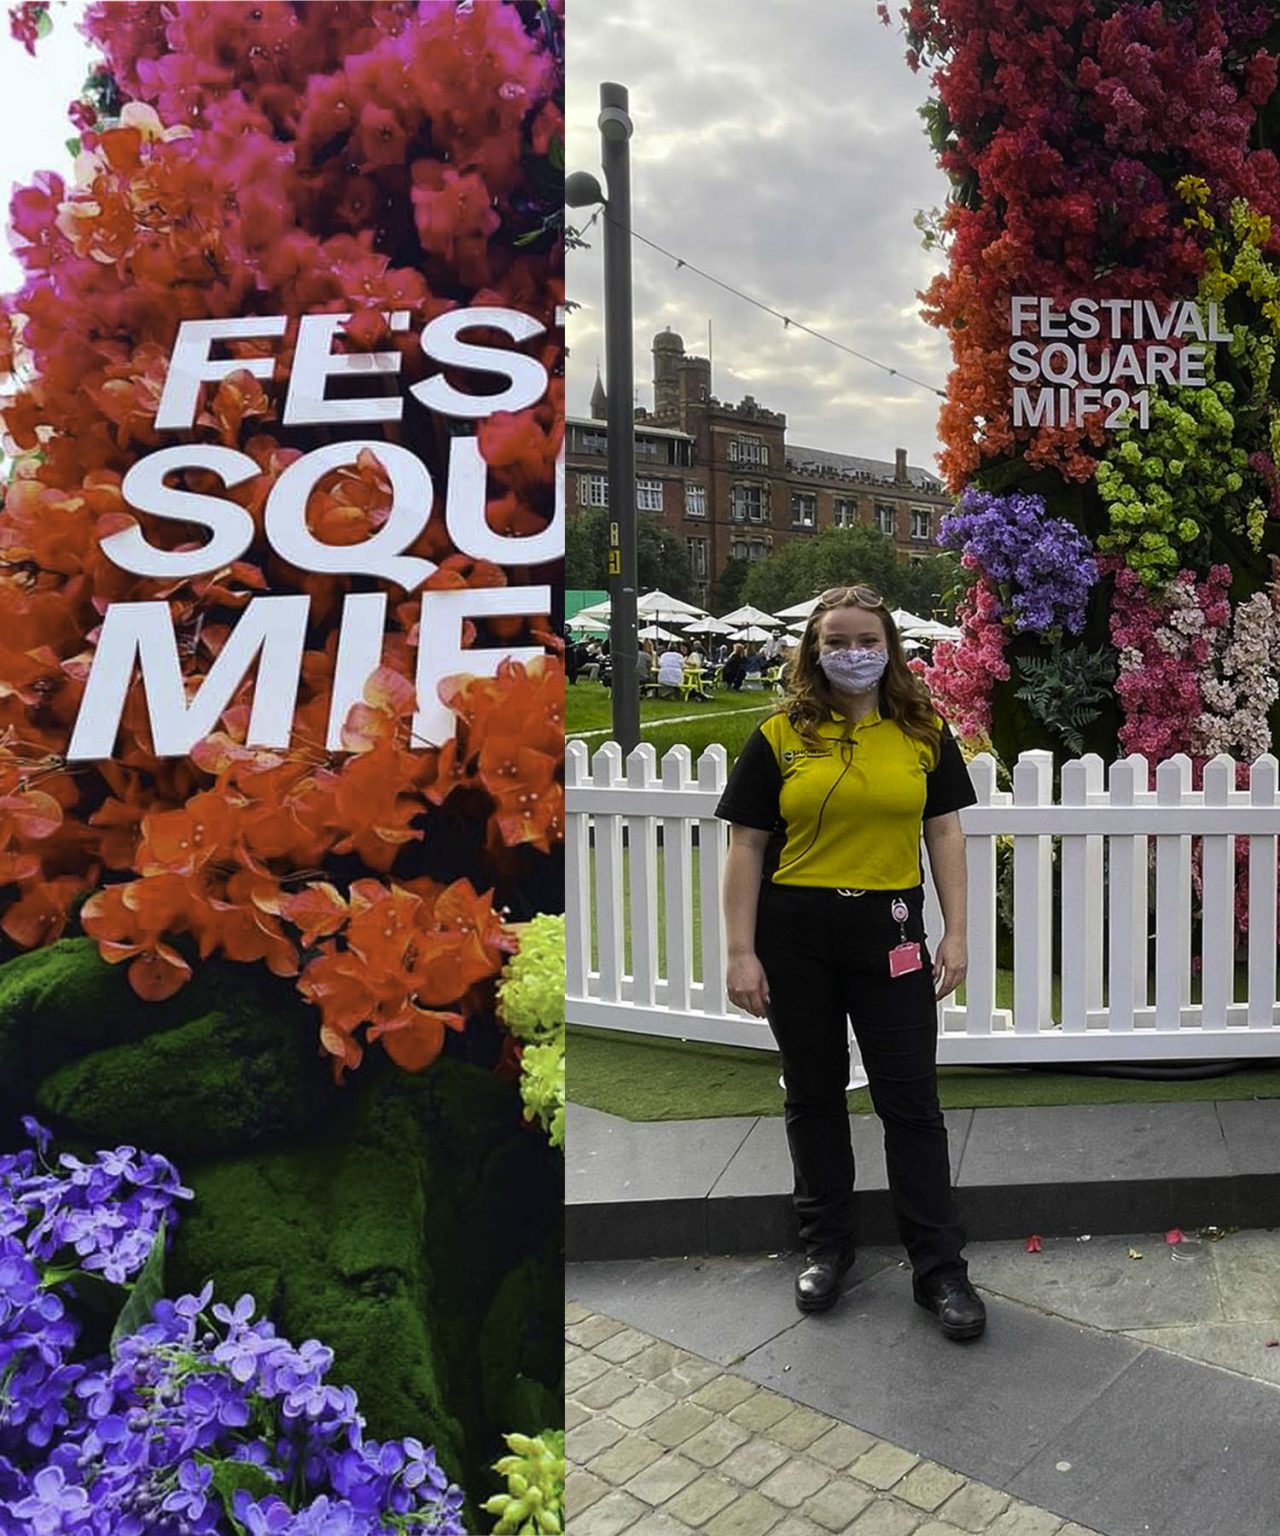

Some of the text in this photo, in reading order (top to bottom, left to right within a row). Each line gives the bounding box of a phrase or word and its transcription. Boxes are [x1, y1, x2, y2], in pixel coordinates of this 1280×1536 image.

[1010, 295, 1234, 342] FESTIVAL
[1007, 340, 1207, 389] SQUARE
[1012, 386, 1150, 430] MIF21
[100, 439, 565, 593] SQU
[66, 584, 552, 763] MIF
